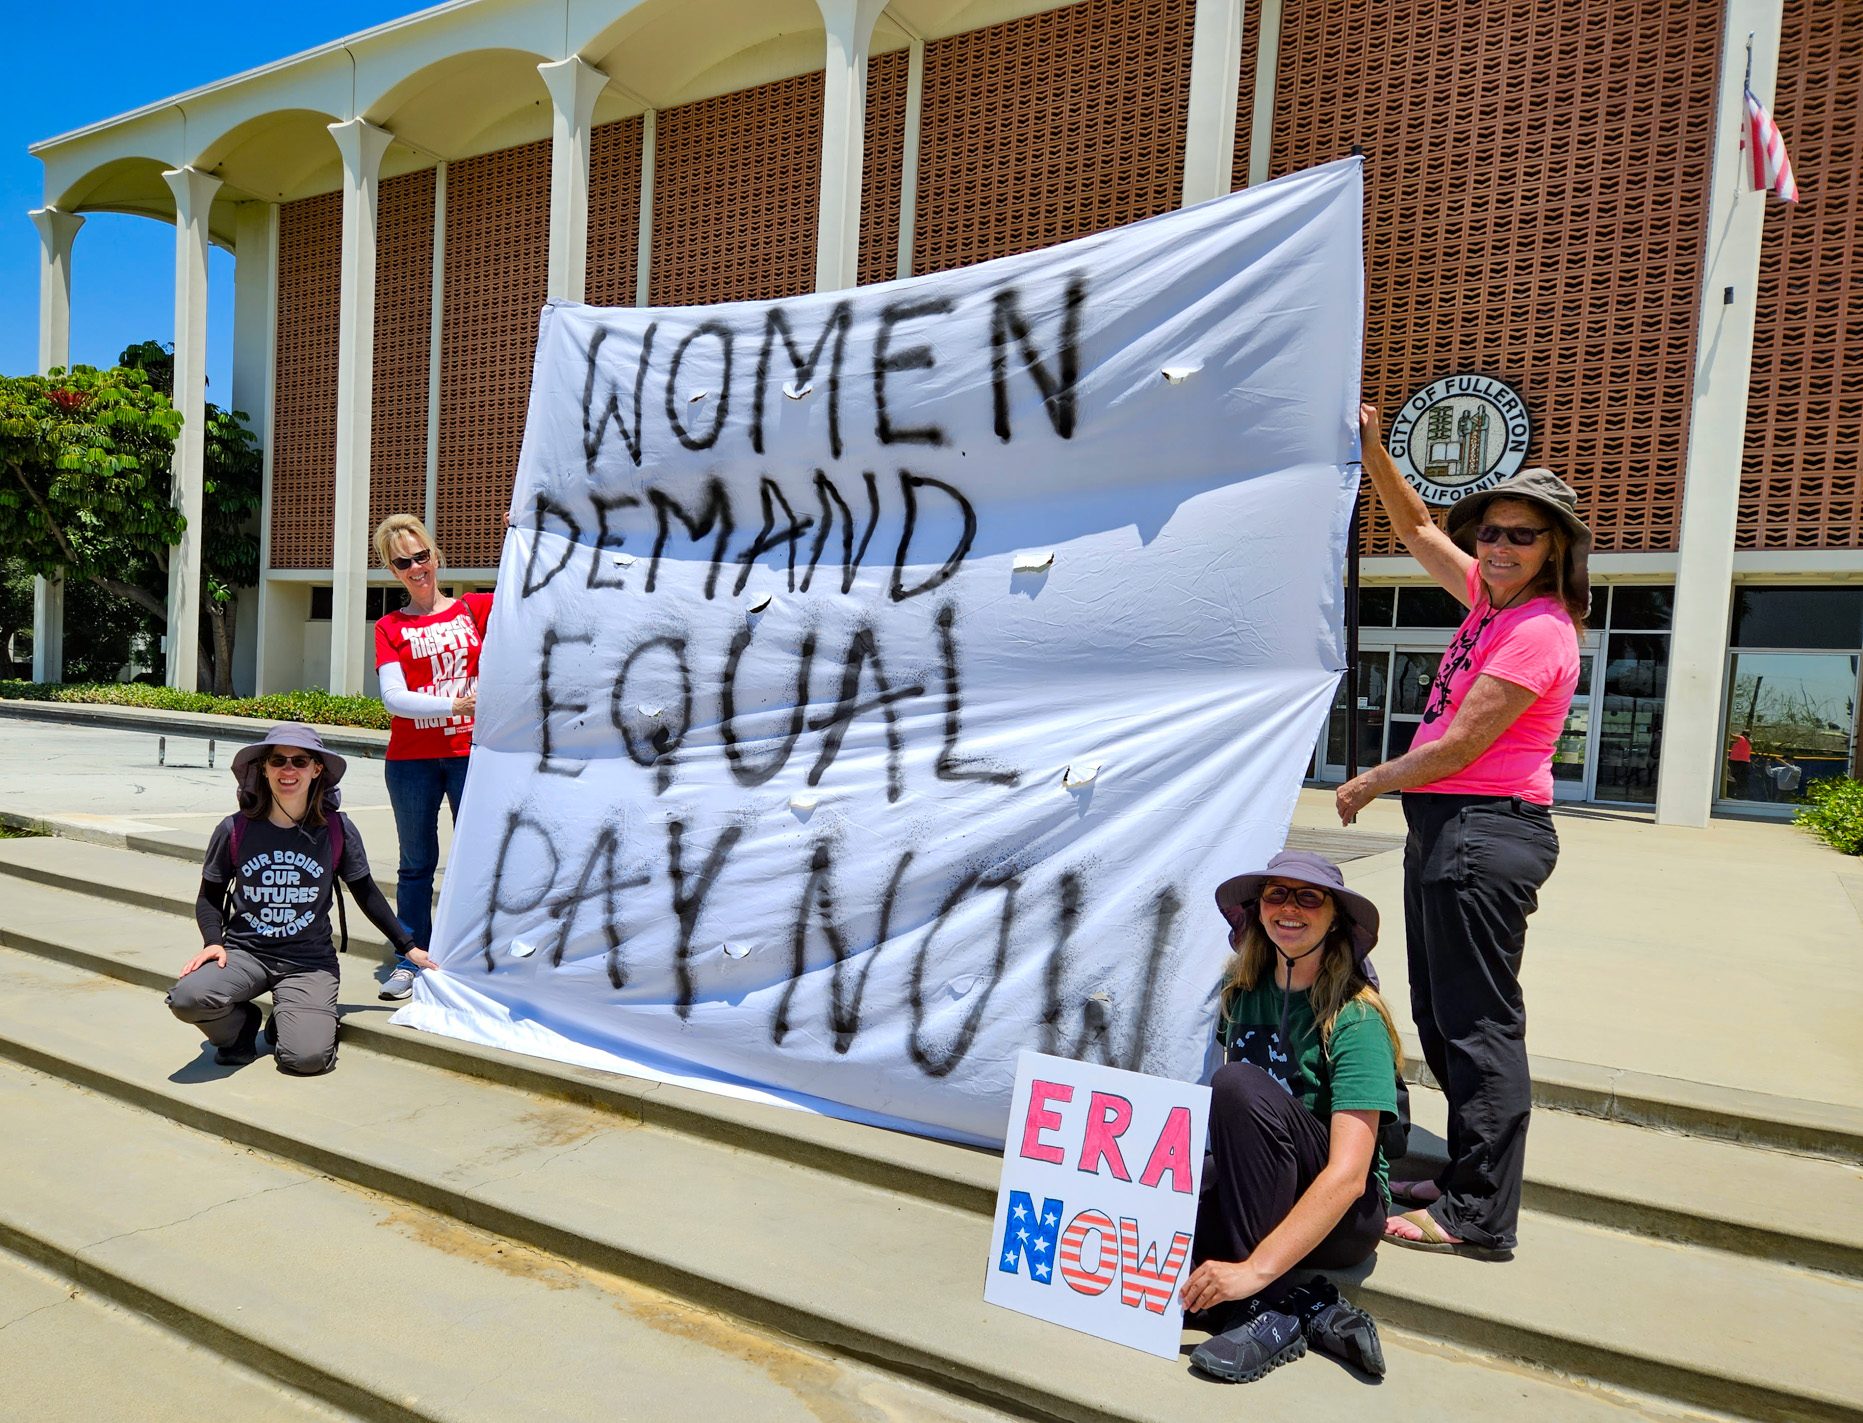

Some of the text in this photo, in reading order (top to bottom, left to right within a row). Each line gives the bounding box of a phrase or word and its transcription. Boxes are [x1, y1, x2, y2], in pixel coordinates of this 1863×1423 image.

[582, 271, 1086, 473] WOMEN
[1391, 377, 1527, 458] CITY OF FULLERTON
[1404, 470, 1507, 501] CALIFORNIA
[522, 468, 977, 601] DEMAND
[409, 627, 478, 660] RIGHTS
[430, 648, 469, 684] ARE
[537, 604, 1020, 802] EQUAL
[241, 850, 324, 878] OUR BODIES
[261, 870, 300, 885] OUR
[242, 885, 320, 903] FUTURES
[241, 910, 315, 937] ABORTIONS
[260, 907, 296, 923] OUR
[483, 811, 1182, 1077] PAY NOW
[1020, 1079, 1193, 1195] ERA
[999, 1190, 1193, 1315] NOW
